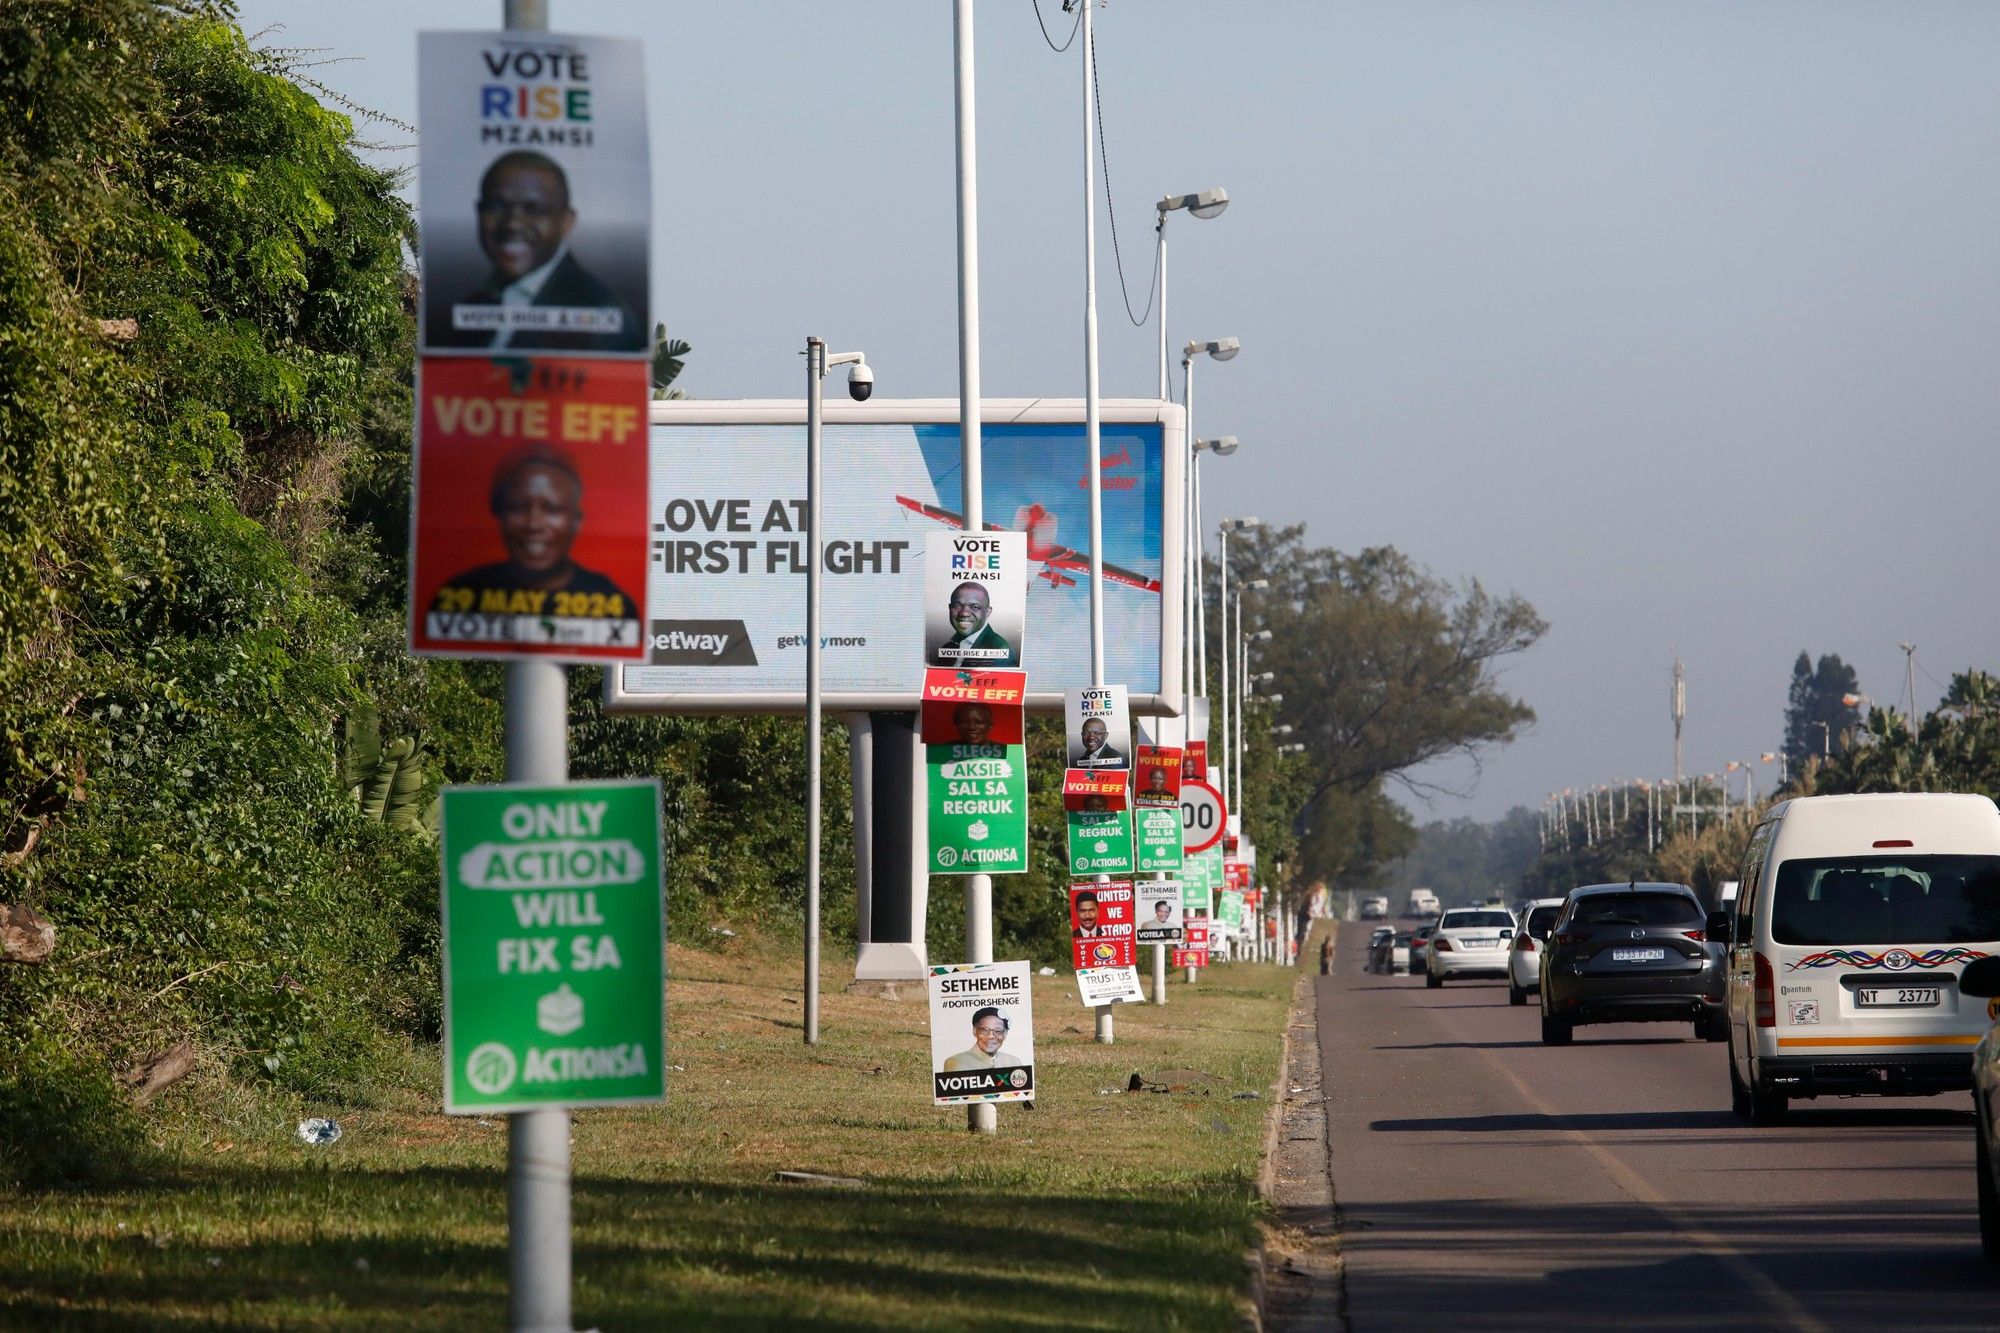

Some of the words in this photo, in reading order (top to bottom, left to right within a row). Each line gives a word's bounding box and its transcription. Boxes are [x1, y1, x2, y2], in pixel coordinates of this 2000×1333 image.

[483, 51, 589, 81] VOTE
[480, 85, 593, 121] RISE
[481, 126, 594, 148] MZANSI
[432, 396, 548, 438] VOTE
[561, 404, 639, 443] EFF
[953, 540, 1000, 552] VOTE
[766, 540, 909, 574] FLGHT
[952, 555, 1000, 569] RISE
[952, 572, 1000, 580] MZANSI
[437, 587, 475, 611] 29
[479, 589, 547, 613] MAY
[553, 592, 625, 617] 2024
[436, 615, 517, 637] VOTE
[976, 678, 998, 687] EFF
[929, 685, 979, 699] VOTE
[984, 688, 1019, 701] EFF
[1082, 691, 1112, 699] VOTE
[1081, 700, 1112, 710] RISE
[952, 744, 1002, 758] SLEGS
[1139, 756, 1161, 766] VOTE
[1163, 758, 1180, 767] EFF
[953, 762, 1002, 776] AKSIE
[948, 781, 980, 796] SAL
[985, 781, 1008, 796] SA
[1068, 782, 1098, 792] VOTE
[1101, 783, 1124, 793] EFF
[943, 800, 1013, 815] REGRUK
[502, 801, 607, 839] ONLY
[1082, 817, 1101, 826] SAL
[1105, 816, 1119, 825] SA
[1181, 803, 1213, 829] 00
[1078, 827, 1123, 838] REGRUK
[1144, 837, 1177, 845] REGRUK
[961, 847, 1018, 863] ACTIONSA
[1091, 857, 1128, 867] ACTIONSA
[483, 849, 628, 882] ACTION
[1097, 890, 1131, 902] UNITED
[1141, 886, 1177, 894] SETHEMBE
[512, 892, 604, 928] WILL
[1107, 907, 1123, 918] WE
[1101, 923, 1132, 936] STAND
[497, 937, 561, 974] FIX
[570, 935, 622, 972] SA
[941, 976, 1019, 993] SETHEMBE
[1084, 974, 1115, 985] TRUST
[1117, 971, 1131, 981] US
[1780, 985, 1812, 996] Quantum
[1860, 990, 1878, 1003] NT
[1899, 989, 1939, 1003] 23771
[942, 997, 1020, 1009] #DOITFORSHENGE
[523, 1043, 648, 1082] ACTIONSA
[939, 1075, 995, 1091] VOTELA
